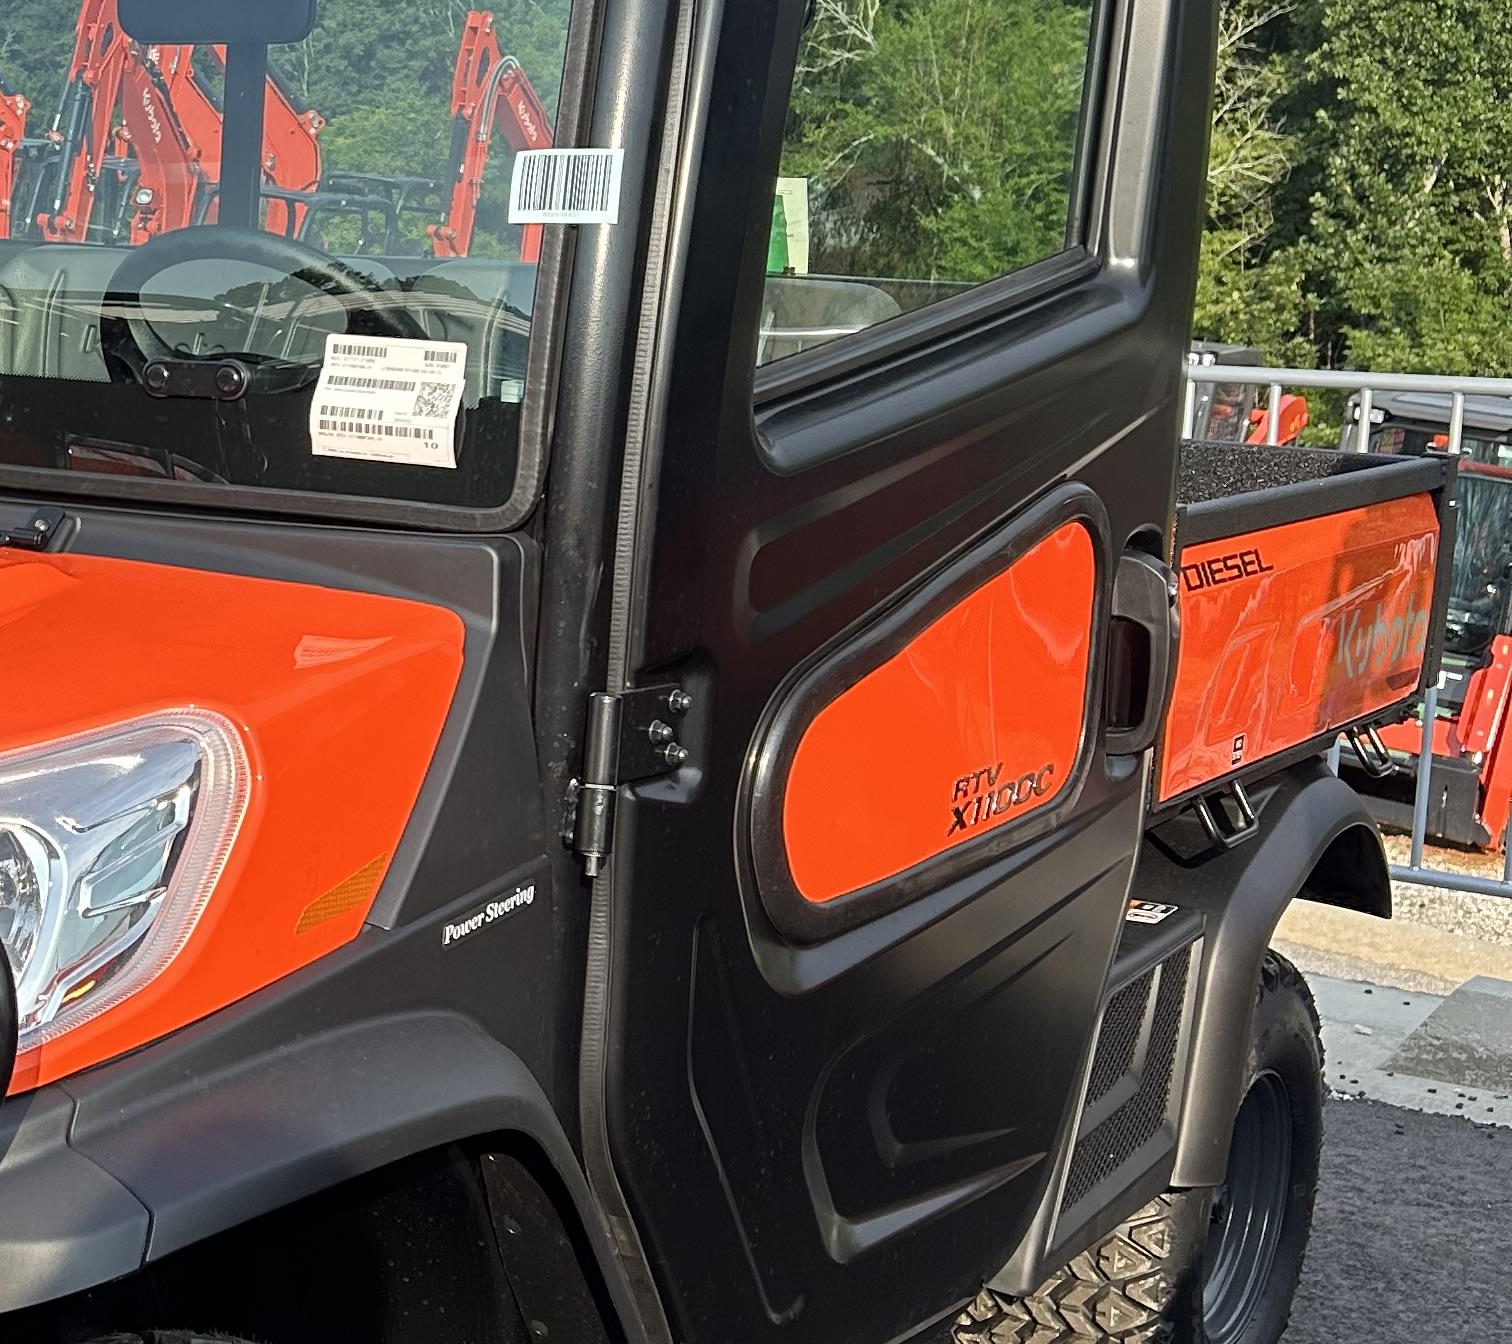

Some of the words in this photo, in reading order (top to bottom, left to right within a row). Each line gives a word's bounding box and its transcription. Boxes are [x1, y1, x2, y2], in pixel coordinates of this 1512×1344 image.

[143, 87, 162, 143] Kubota
[1181, 548, 1274, 592] DIESEL
[1337, 592, 1426, 679] Kubota
[946, 762, 1055, 837] X1100C
[952, 761, 1004, 802] RTV
[443, 912, 485, 945] Power
[485, 885, 535, 923] Steering
